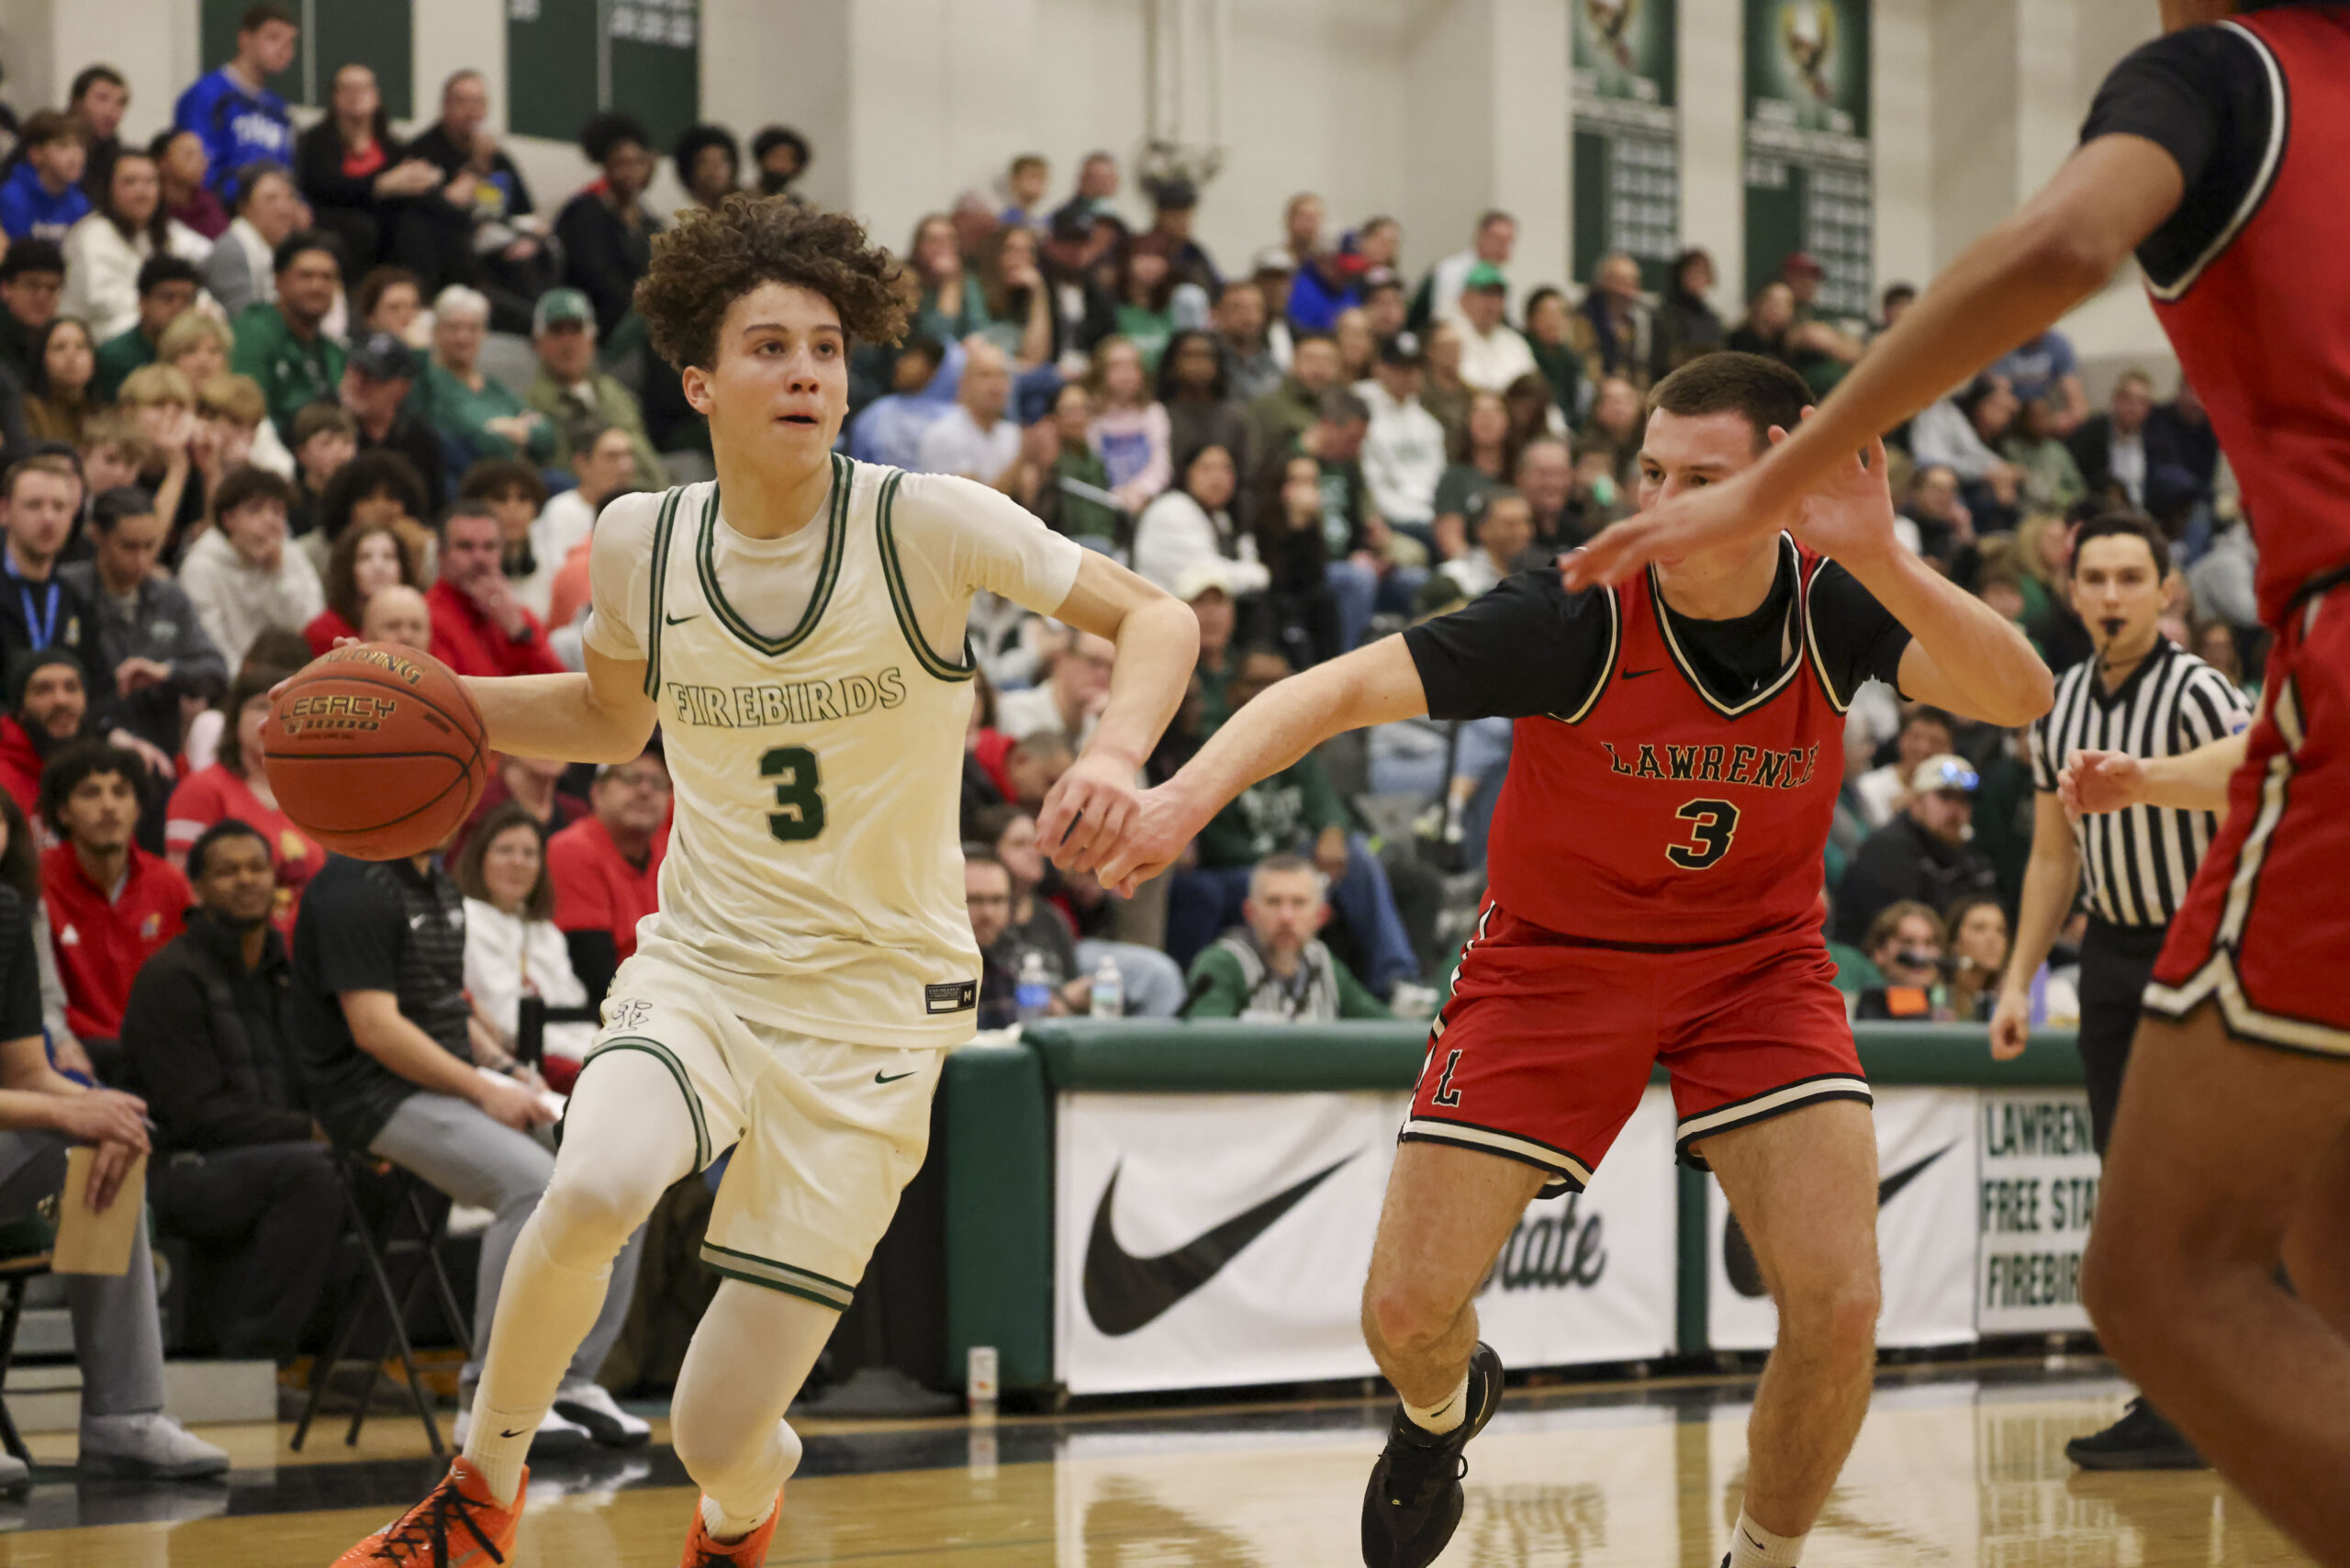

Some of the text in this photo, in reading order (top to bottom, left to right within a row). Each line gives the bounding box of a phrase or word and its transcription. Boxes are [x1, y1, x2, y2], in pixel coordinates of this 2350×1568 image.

[280, 695, 397, 721] LEGACY
[666, 666, 907, 729] FIREBIRDS
[1601, 740, 1820, 790] LAWRENCE
[757, 744, 828, 844] 3
[1664, 797, 1741, 870] 3
[963, 990, 972, 1002] M
[1432, 1048, 1463, 1108] L
[1986, 1103, 2094, 1157] LAWREN
[1981, 1178, 2098, 1231] FREE STA
[1478, 1192, 1608, 1290] tate
[1986, 1252, 2081, 1308] FIREBIR
